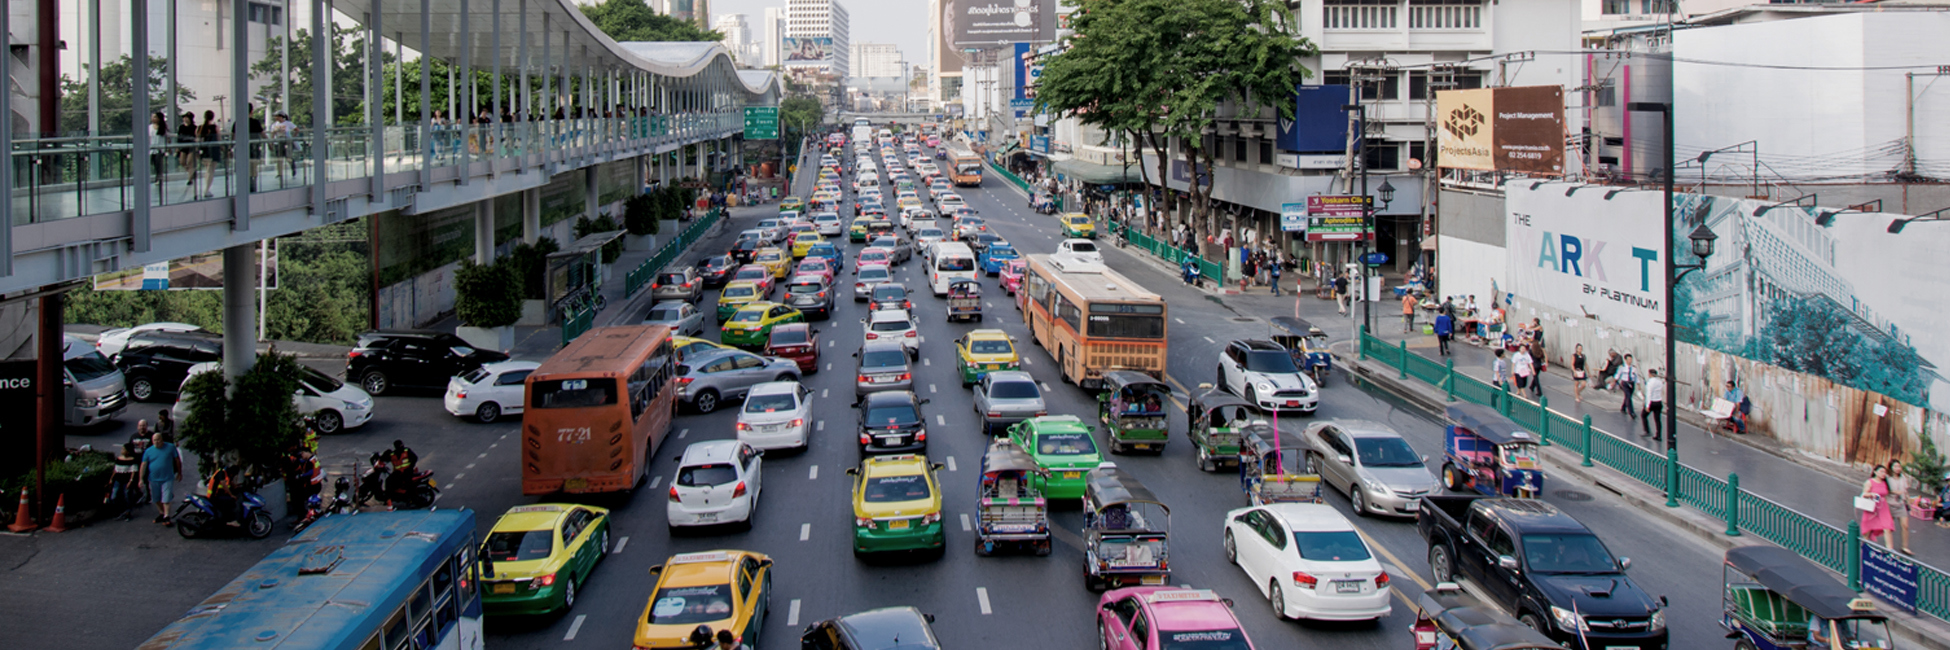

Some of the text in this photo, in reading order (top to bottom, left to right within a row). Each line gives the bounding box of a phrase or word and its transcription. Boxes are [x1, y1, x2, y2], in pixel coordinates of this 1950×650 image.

[1499, 112, 1554, 120] Project Management
[1440, 145, 1490, 157] ProjectsAsia
[1321, 196, 1372, 204] Yoskarn Clinc
[1513, 212, 1531, 227] THE
[557, 427, 591, 442] 77-21
